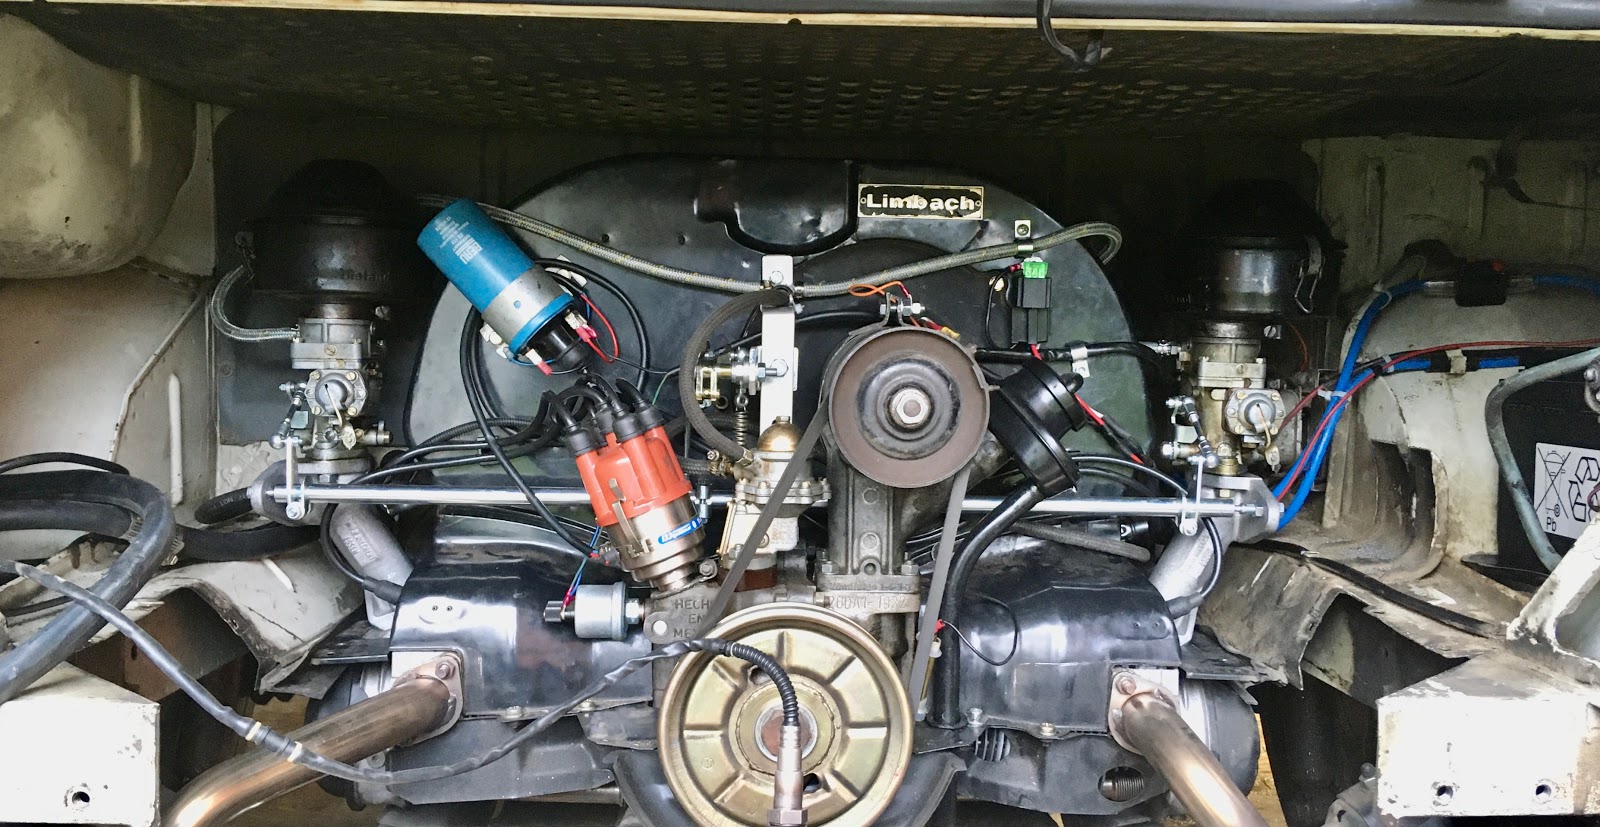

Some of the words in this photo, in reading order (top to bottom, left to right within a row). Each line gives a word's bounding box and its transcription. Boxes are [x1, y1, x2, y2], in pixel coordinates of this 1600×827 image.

[865, 193, 975, 211] Limbach
[459, 240, 483, 265] BERU
[1546, 516, 1557, 532] Pb
[675, 599, 711, 610] HECH
[688, 613, 705, 624] EN
